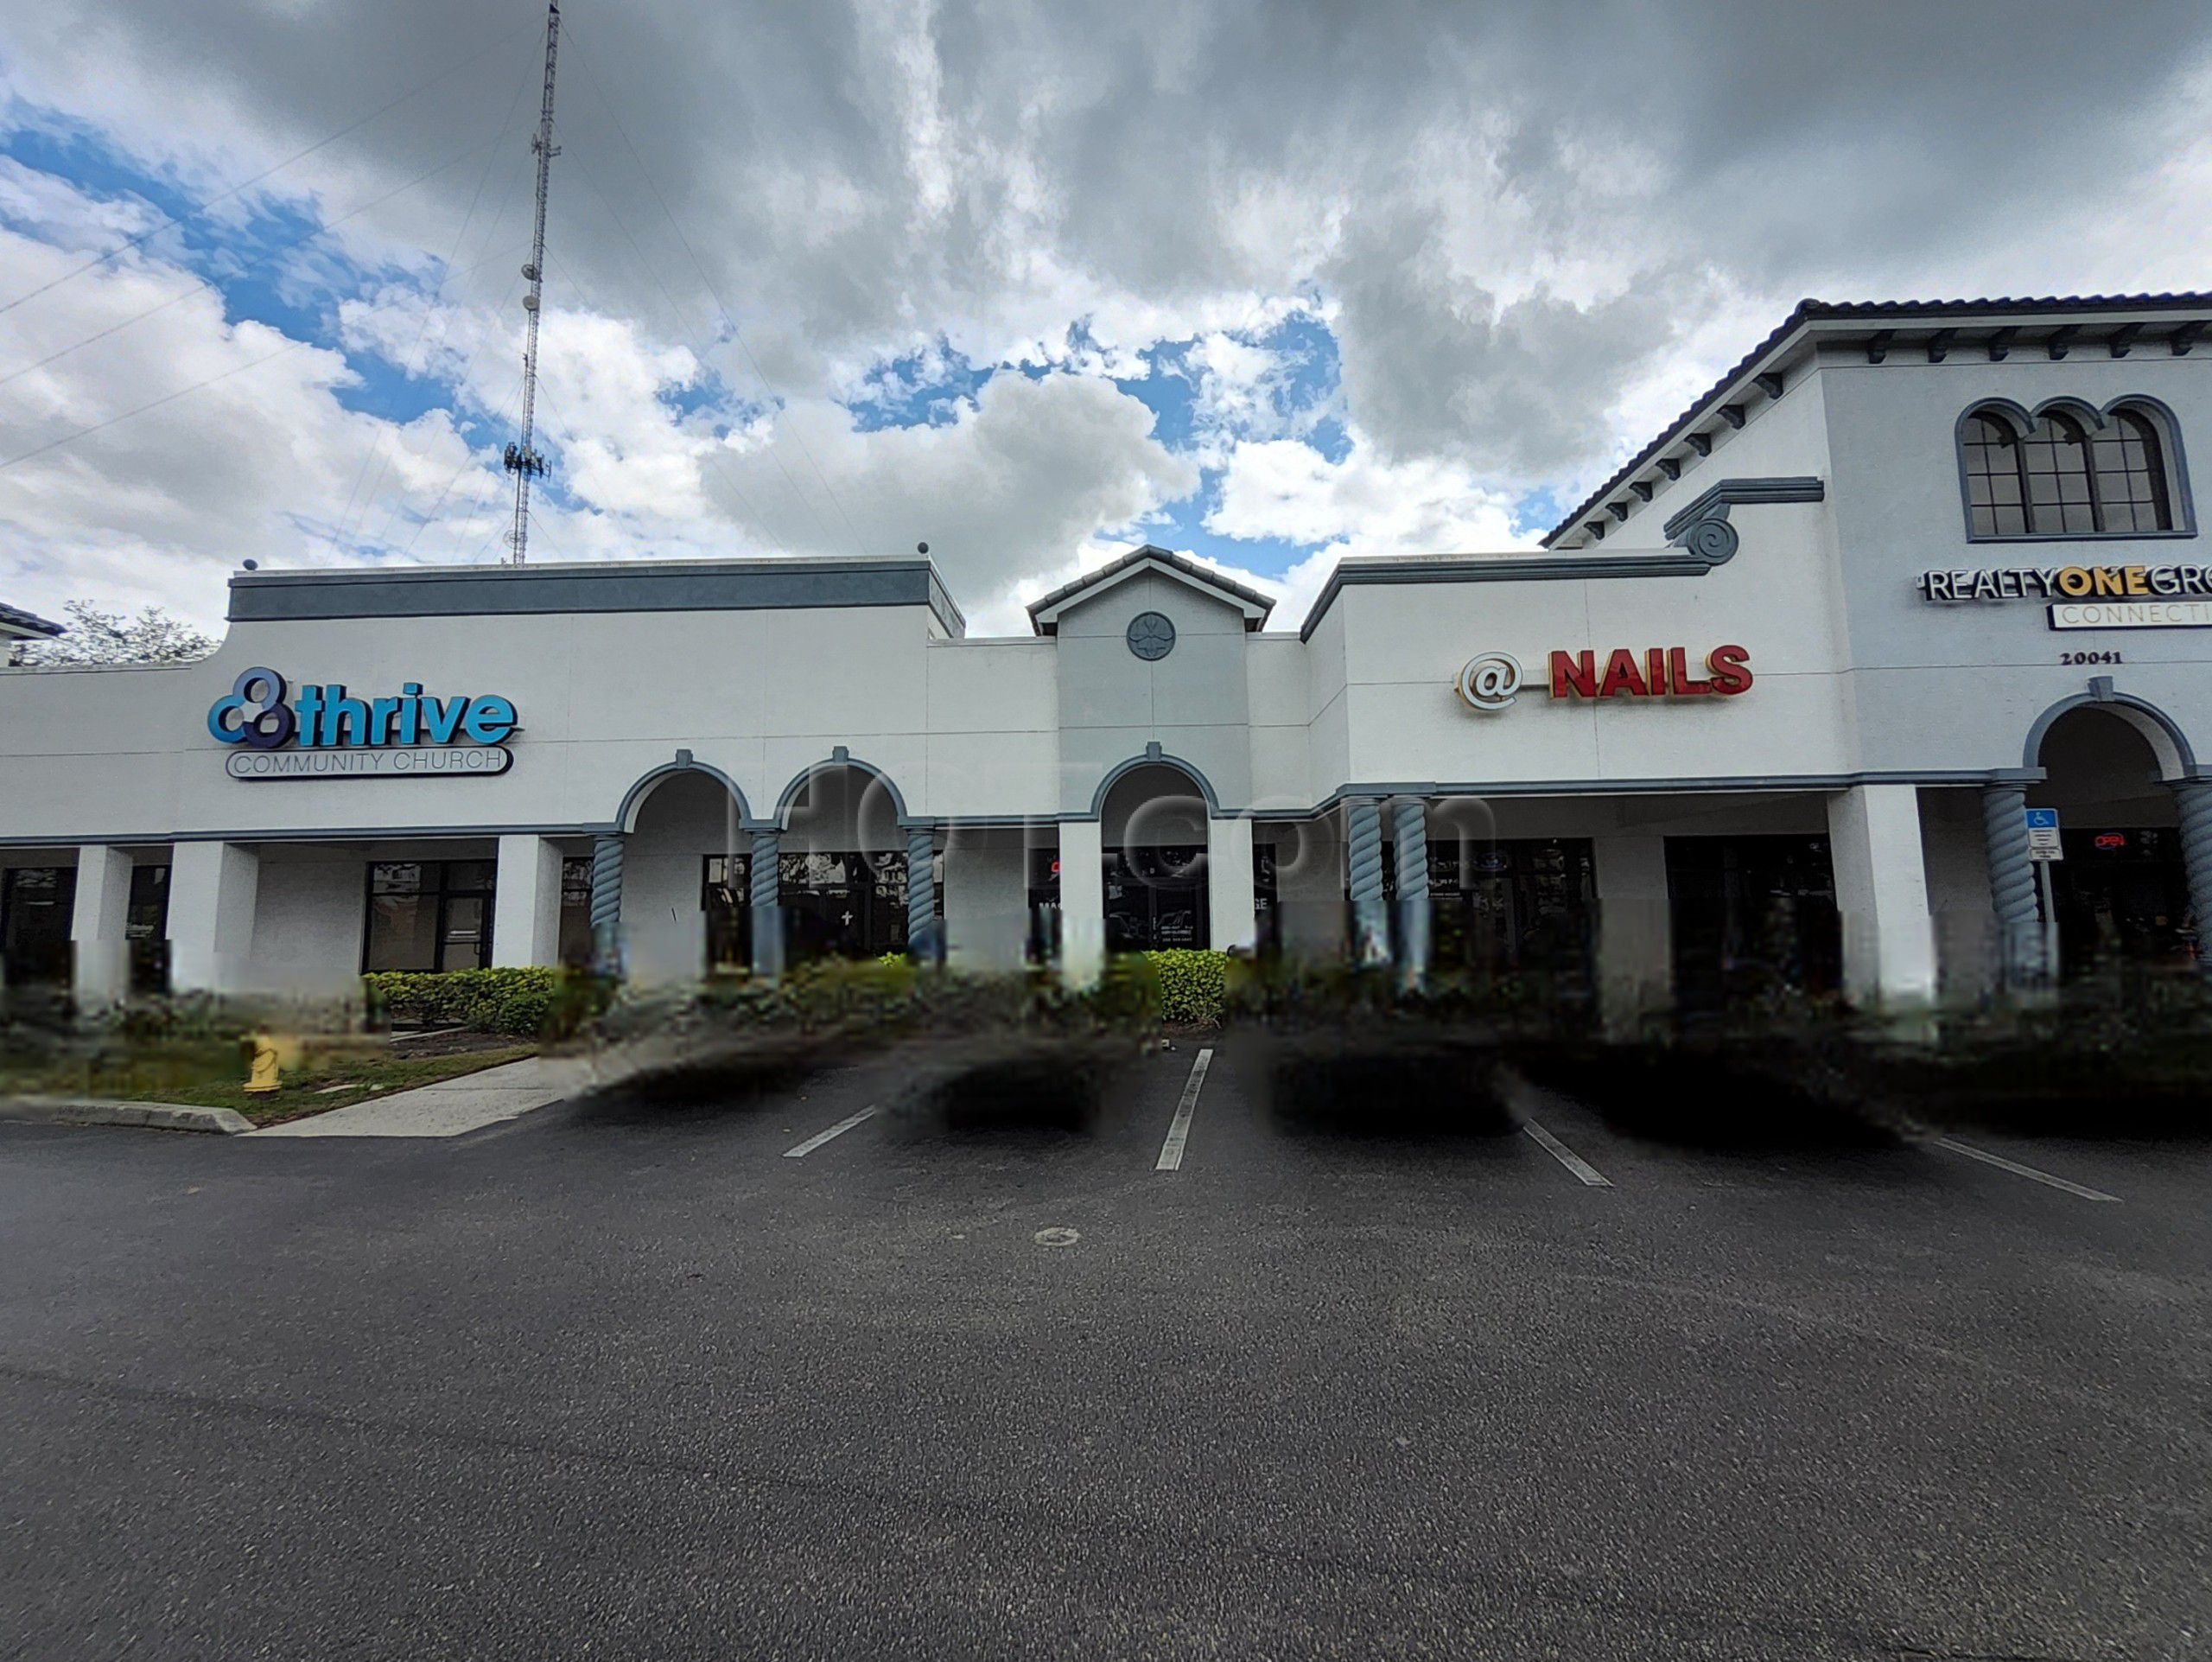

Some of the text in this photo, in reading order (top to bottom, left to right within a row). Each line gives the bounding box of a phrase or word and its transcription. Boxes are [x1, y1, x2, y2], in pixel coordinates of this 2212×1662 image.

[1457, 644, 1754, 710] @ NAILS
[2060, 651, 2123, 665] 20041
[295, 683, 518, 747] thrive
[233, 750, 502, 774] COMMUNITY CHURCH
